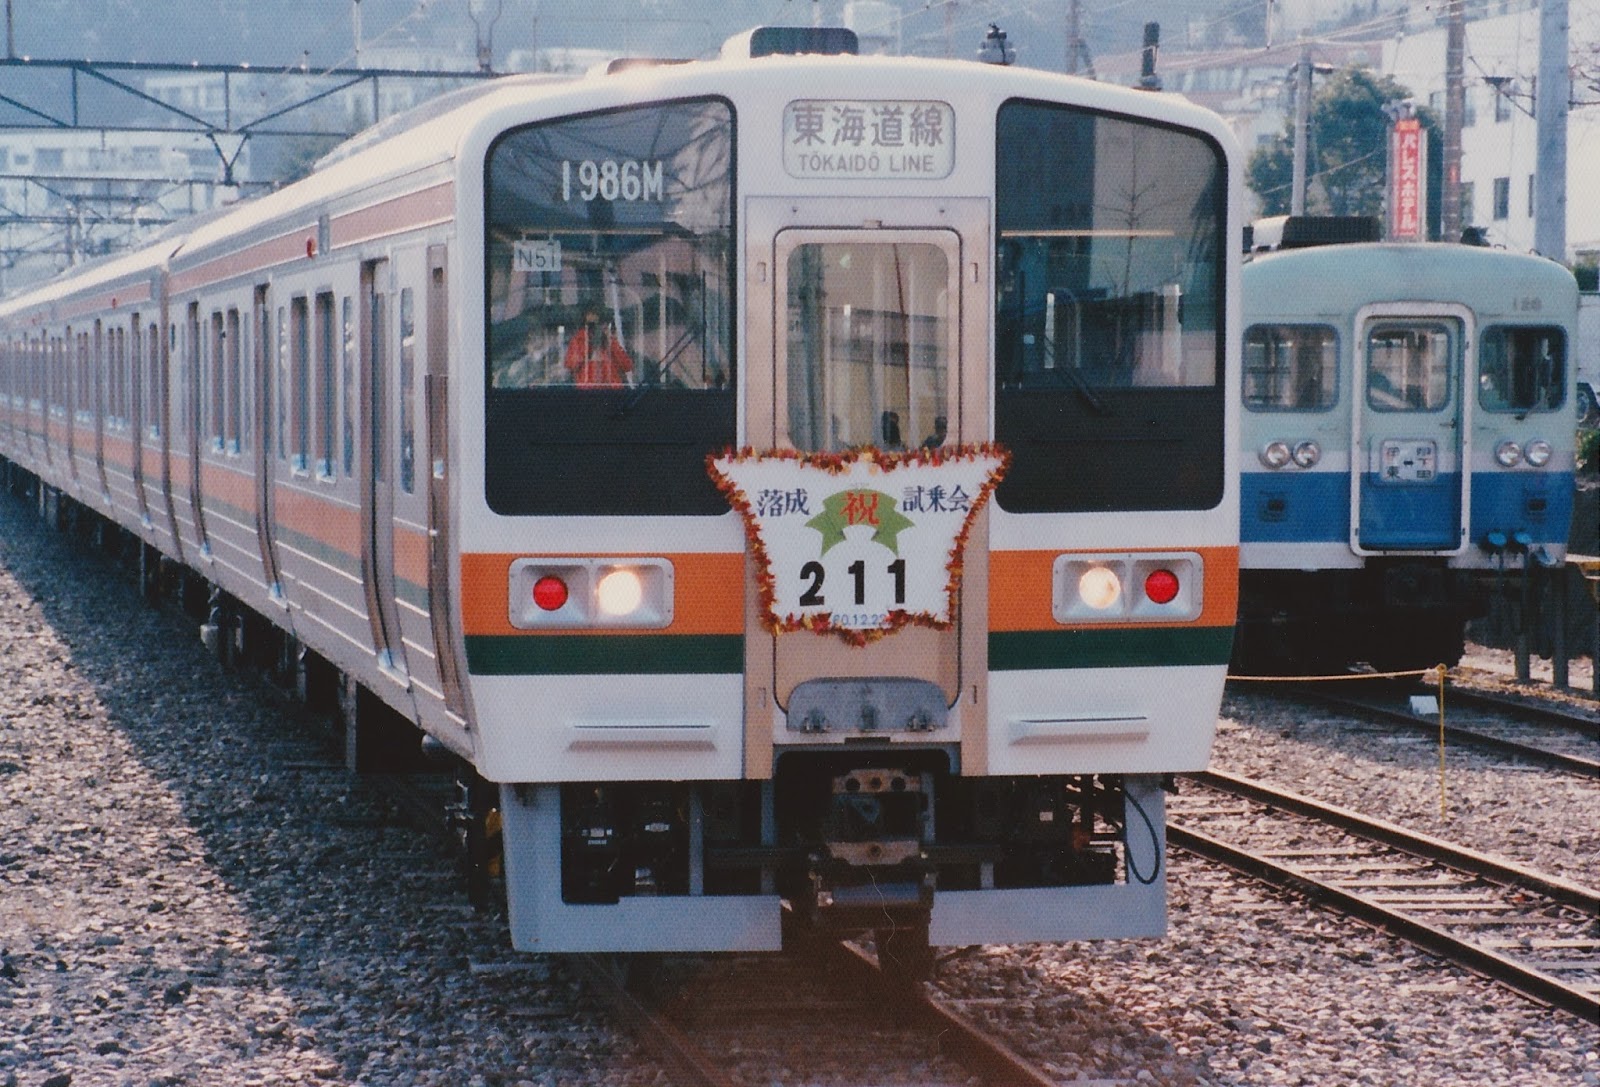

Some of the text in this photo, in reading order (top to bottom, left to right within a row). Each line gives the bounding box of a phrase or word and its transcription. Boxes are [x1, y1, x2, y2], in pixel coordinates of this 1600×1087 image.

[792, 104, 943, 147] 東海道線
[889, 154, 934, 172] LINE
[562, 160, 663, 201] 1986M
[518, 248, 555, 268] N51
[757, 488, 810, 517] 落成
[840, 492, 881, 526] 祝
[902, 485, 970, 513] 試乗会
[799, 559, 906, 606] 211
